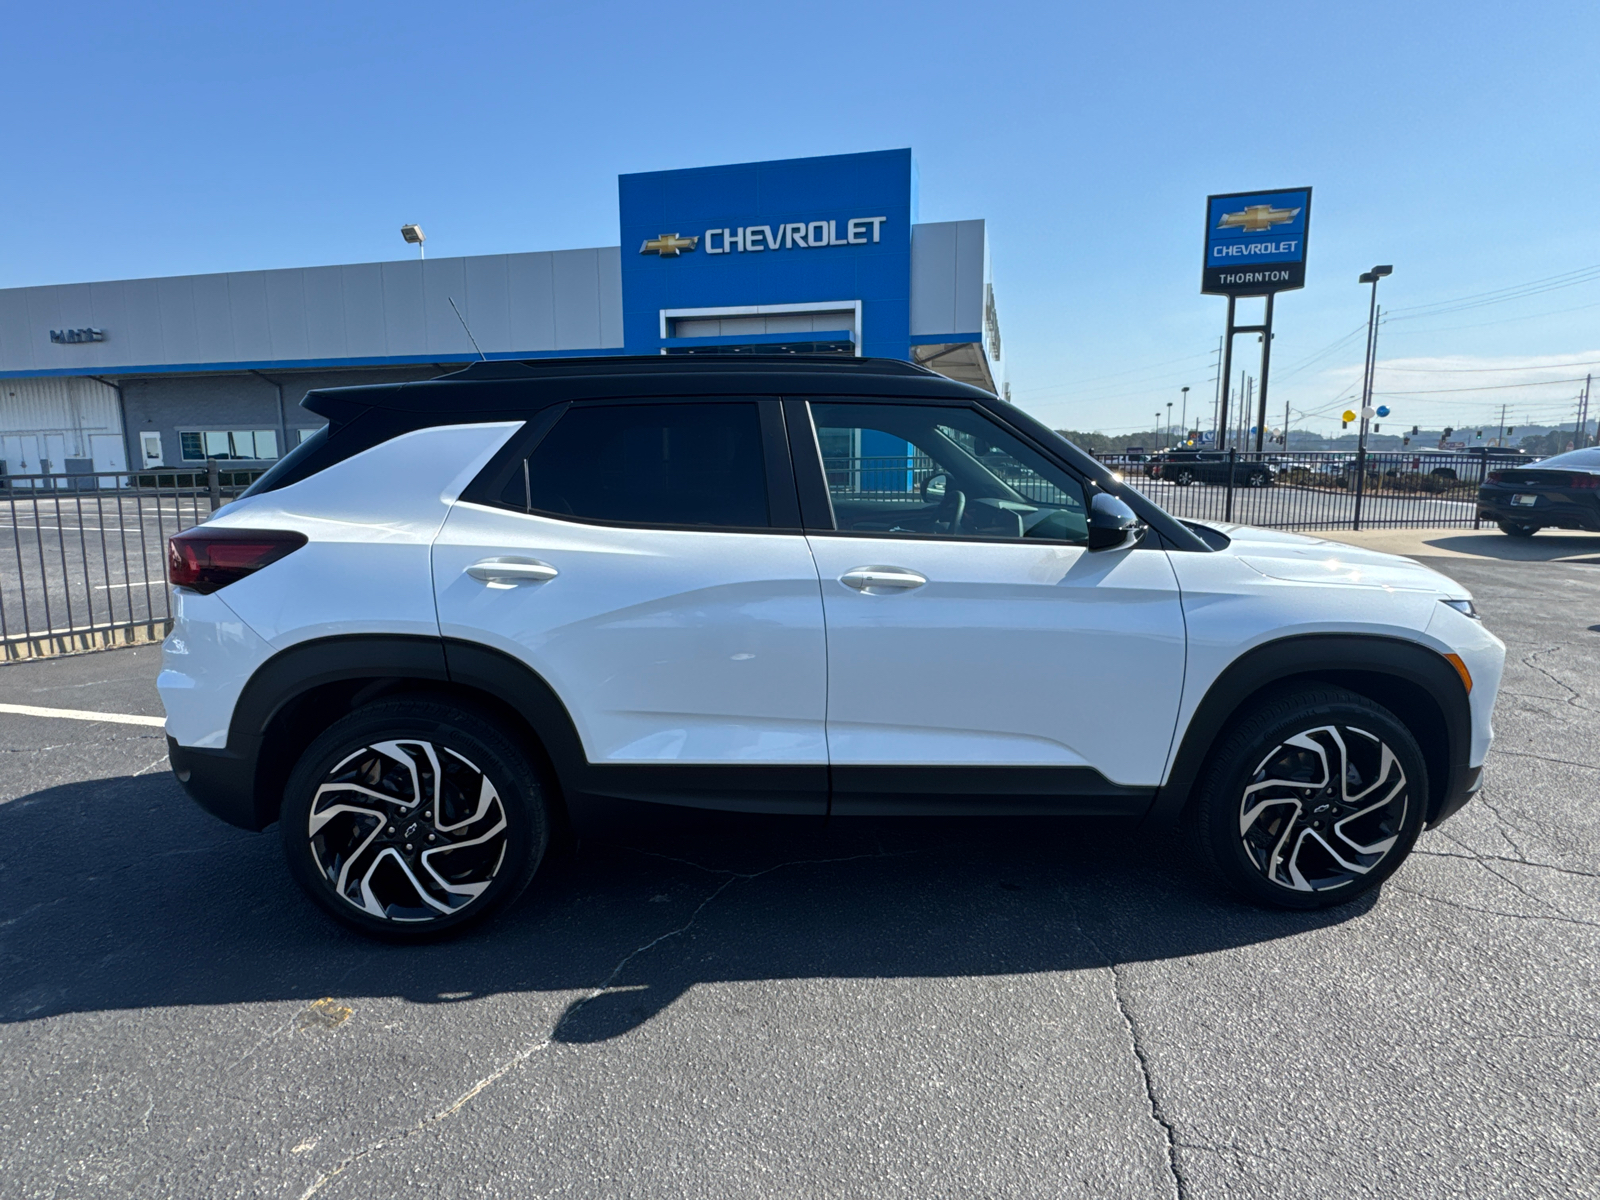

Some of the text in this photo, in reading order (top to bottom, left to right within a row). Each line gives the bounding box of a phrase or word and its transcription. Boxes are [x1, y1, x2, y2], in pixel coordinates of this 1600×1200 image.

[705, 216, 886, 254] CHEVROLET
[1213, 240, 1298, 257] CHEVROLET
[1219, 270, 1289, 284] THORNTON
